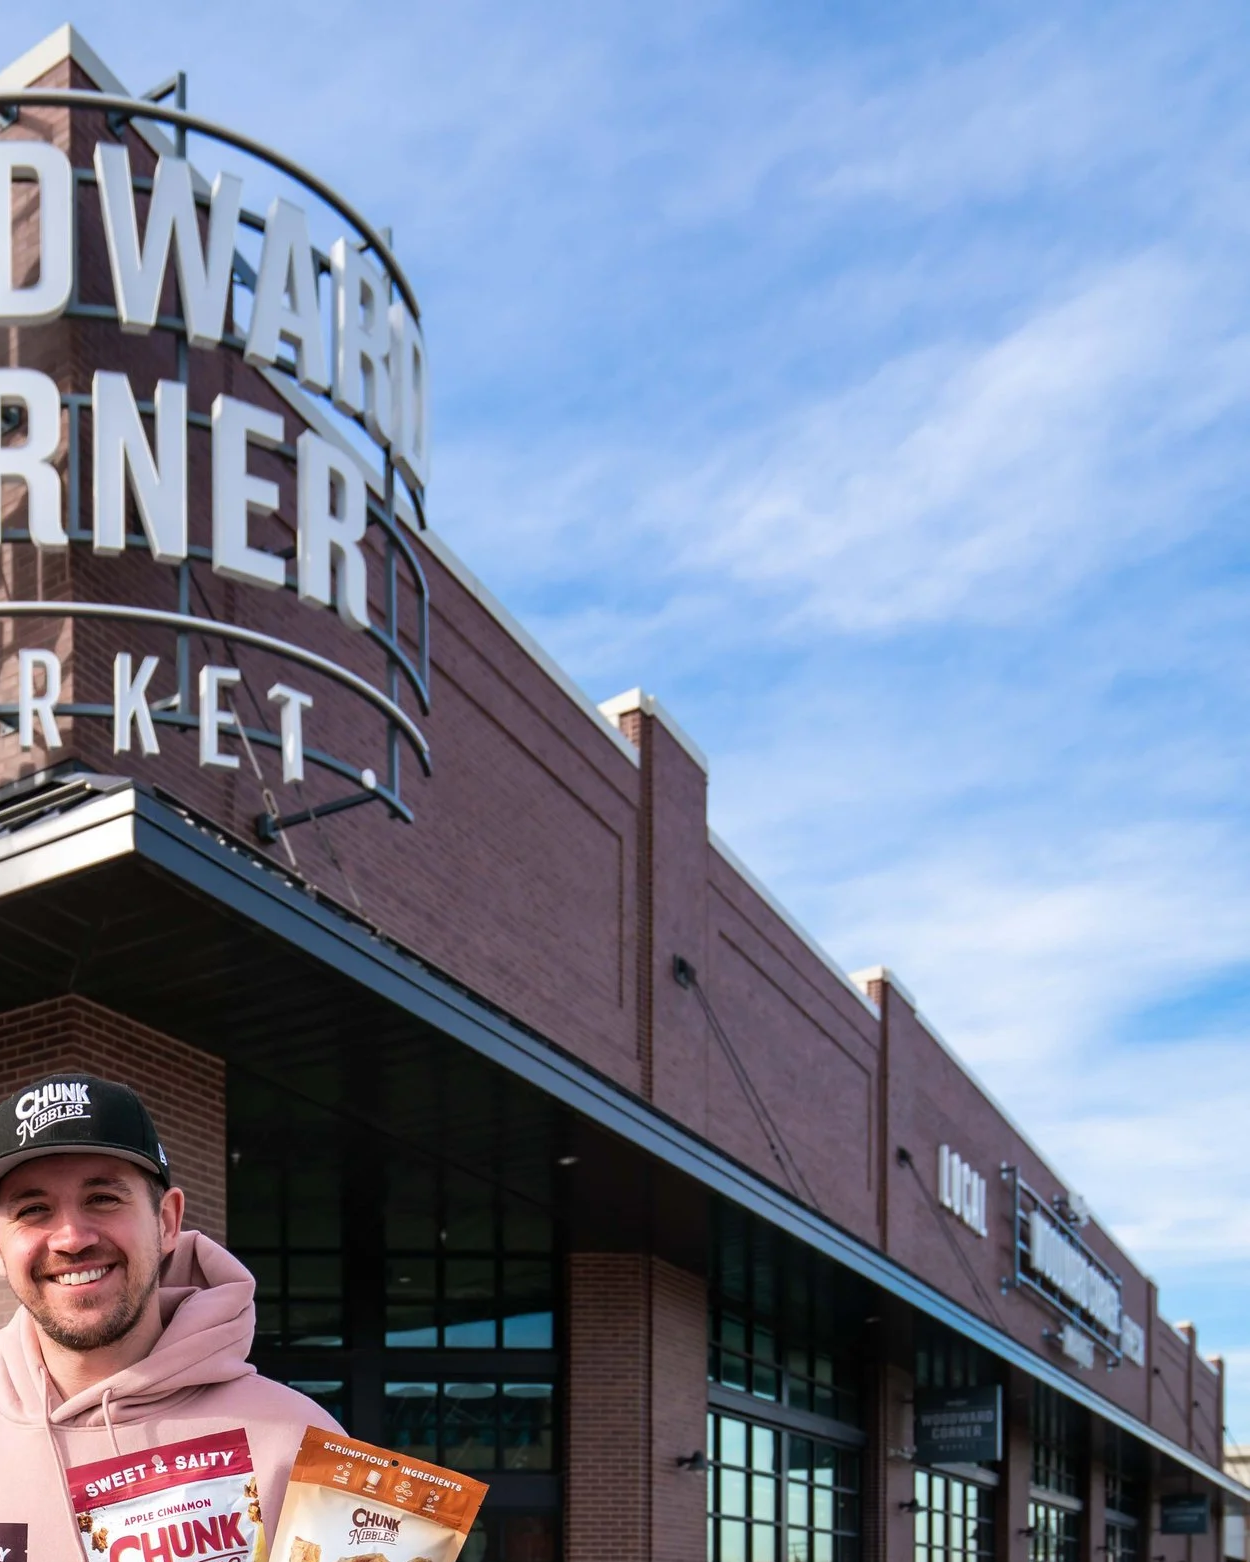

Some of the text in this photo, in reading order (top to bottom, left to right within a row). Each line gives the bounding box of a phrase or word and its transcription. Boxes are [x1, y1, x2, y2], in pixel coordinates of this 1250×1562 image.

[15, 1083, 90, 1120] CHUNK
[16, 1103, 90, 1146] NIBBLES
[85, 1452, 233, 1497] SWEET & SALTY
[324, 1442, 462, 1491] SCRUMPTIOUS INGREDIENTS
[124, 1498, 211, 1526] APPLE CINNAMON
[352, 1508, 401, 1532] CHUNK
[348, 1528, 398, 1545] NIBBLES
